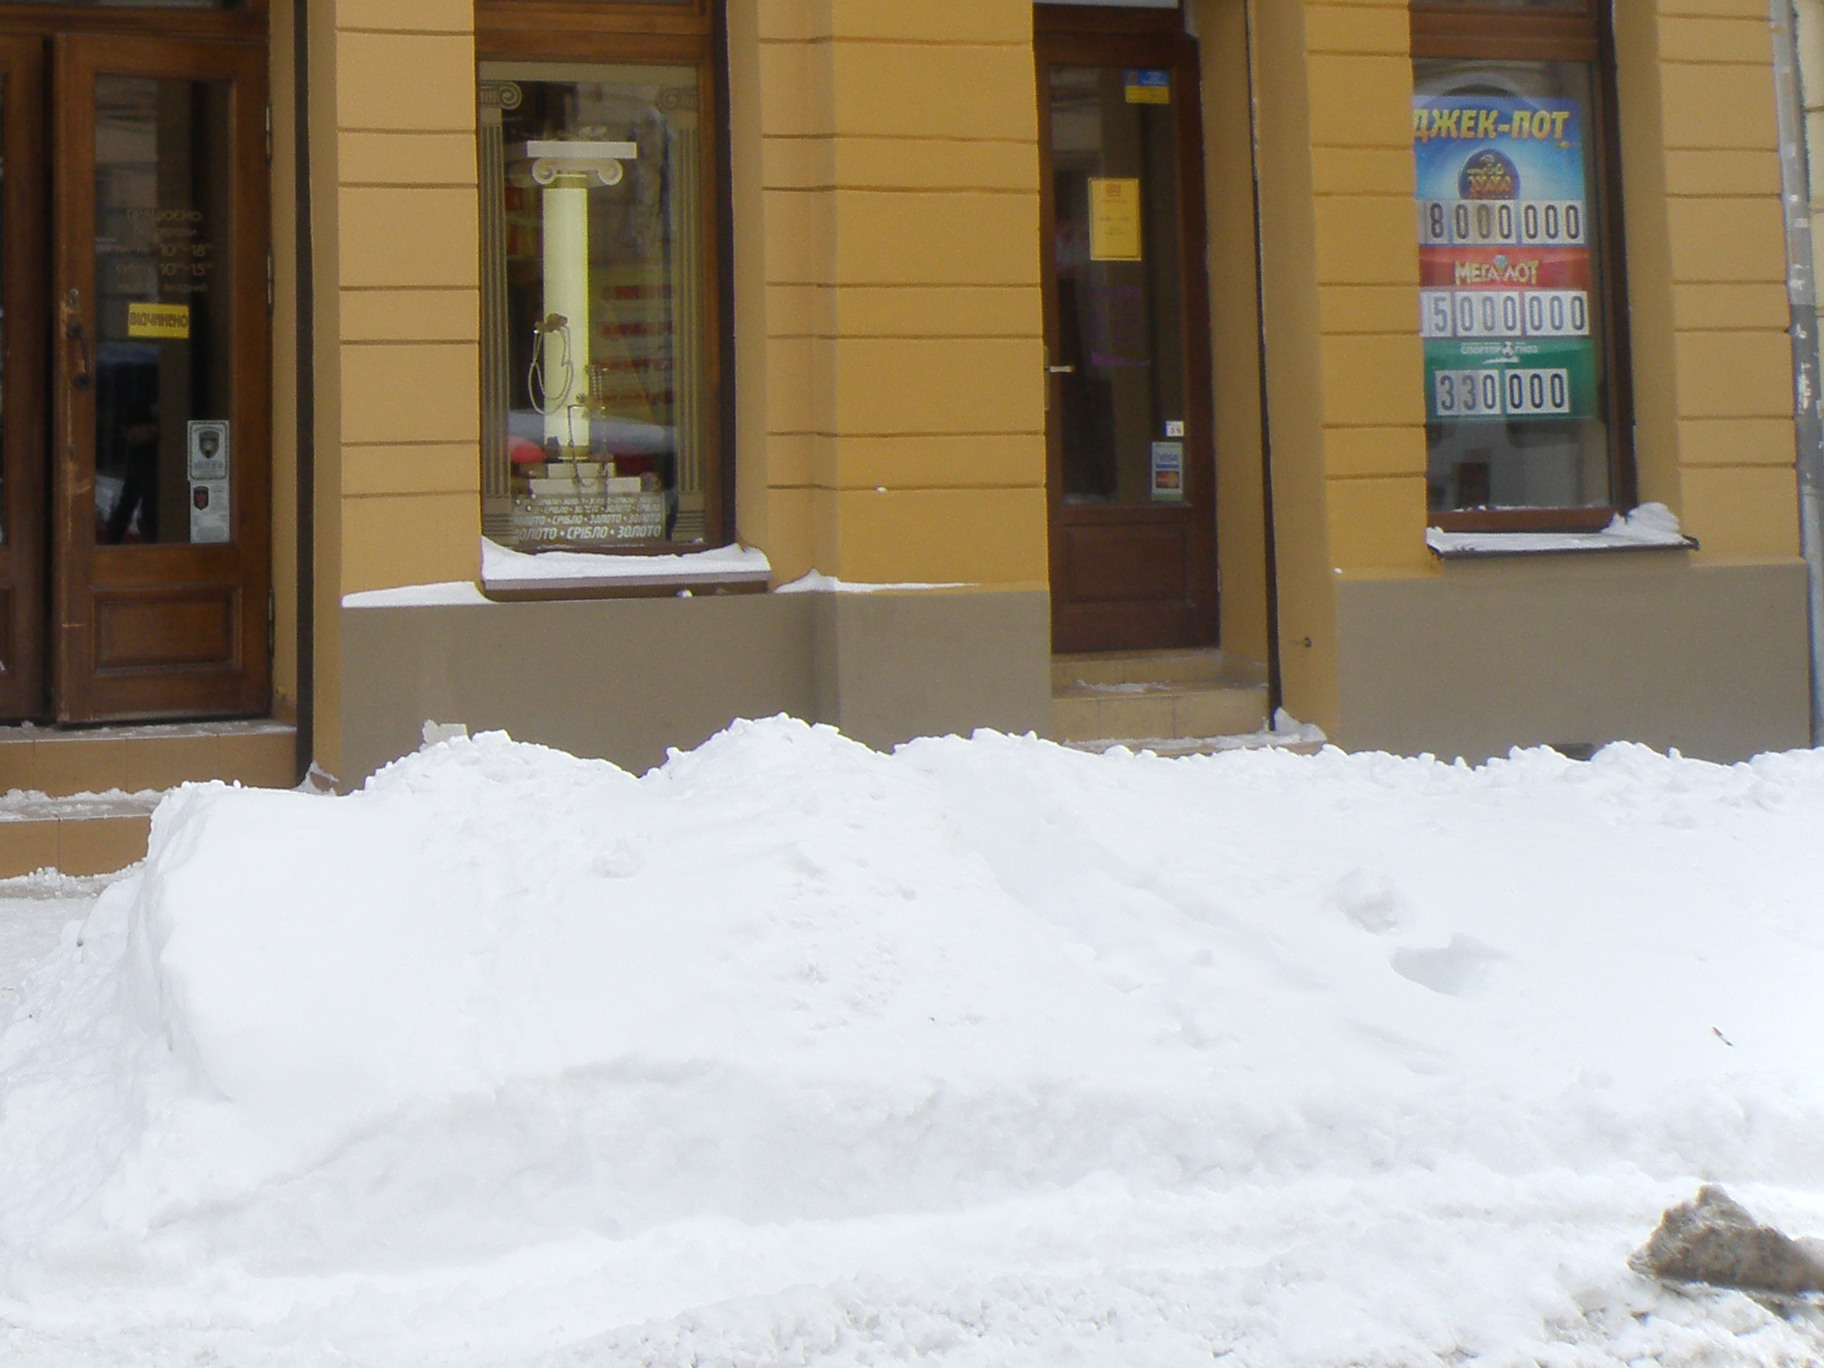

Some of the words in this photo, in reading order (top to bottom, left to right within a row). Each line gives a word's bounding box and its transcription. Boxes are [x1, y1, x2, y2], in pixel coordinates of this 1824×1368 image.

[1412, 109, 1570, 143] ДЖЕК-ПОТ
[566, 527, 609, 540] СРІБЛО
[617, 525, 662, 539] ЗОЛОТО
